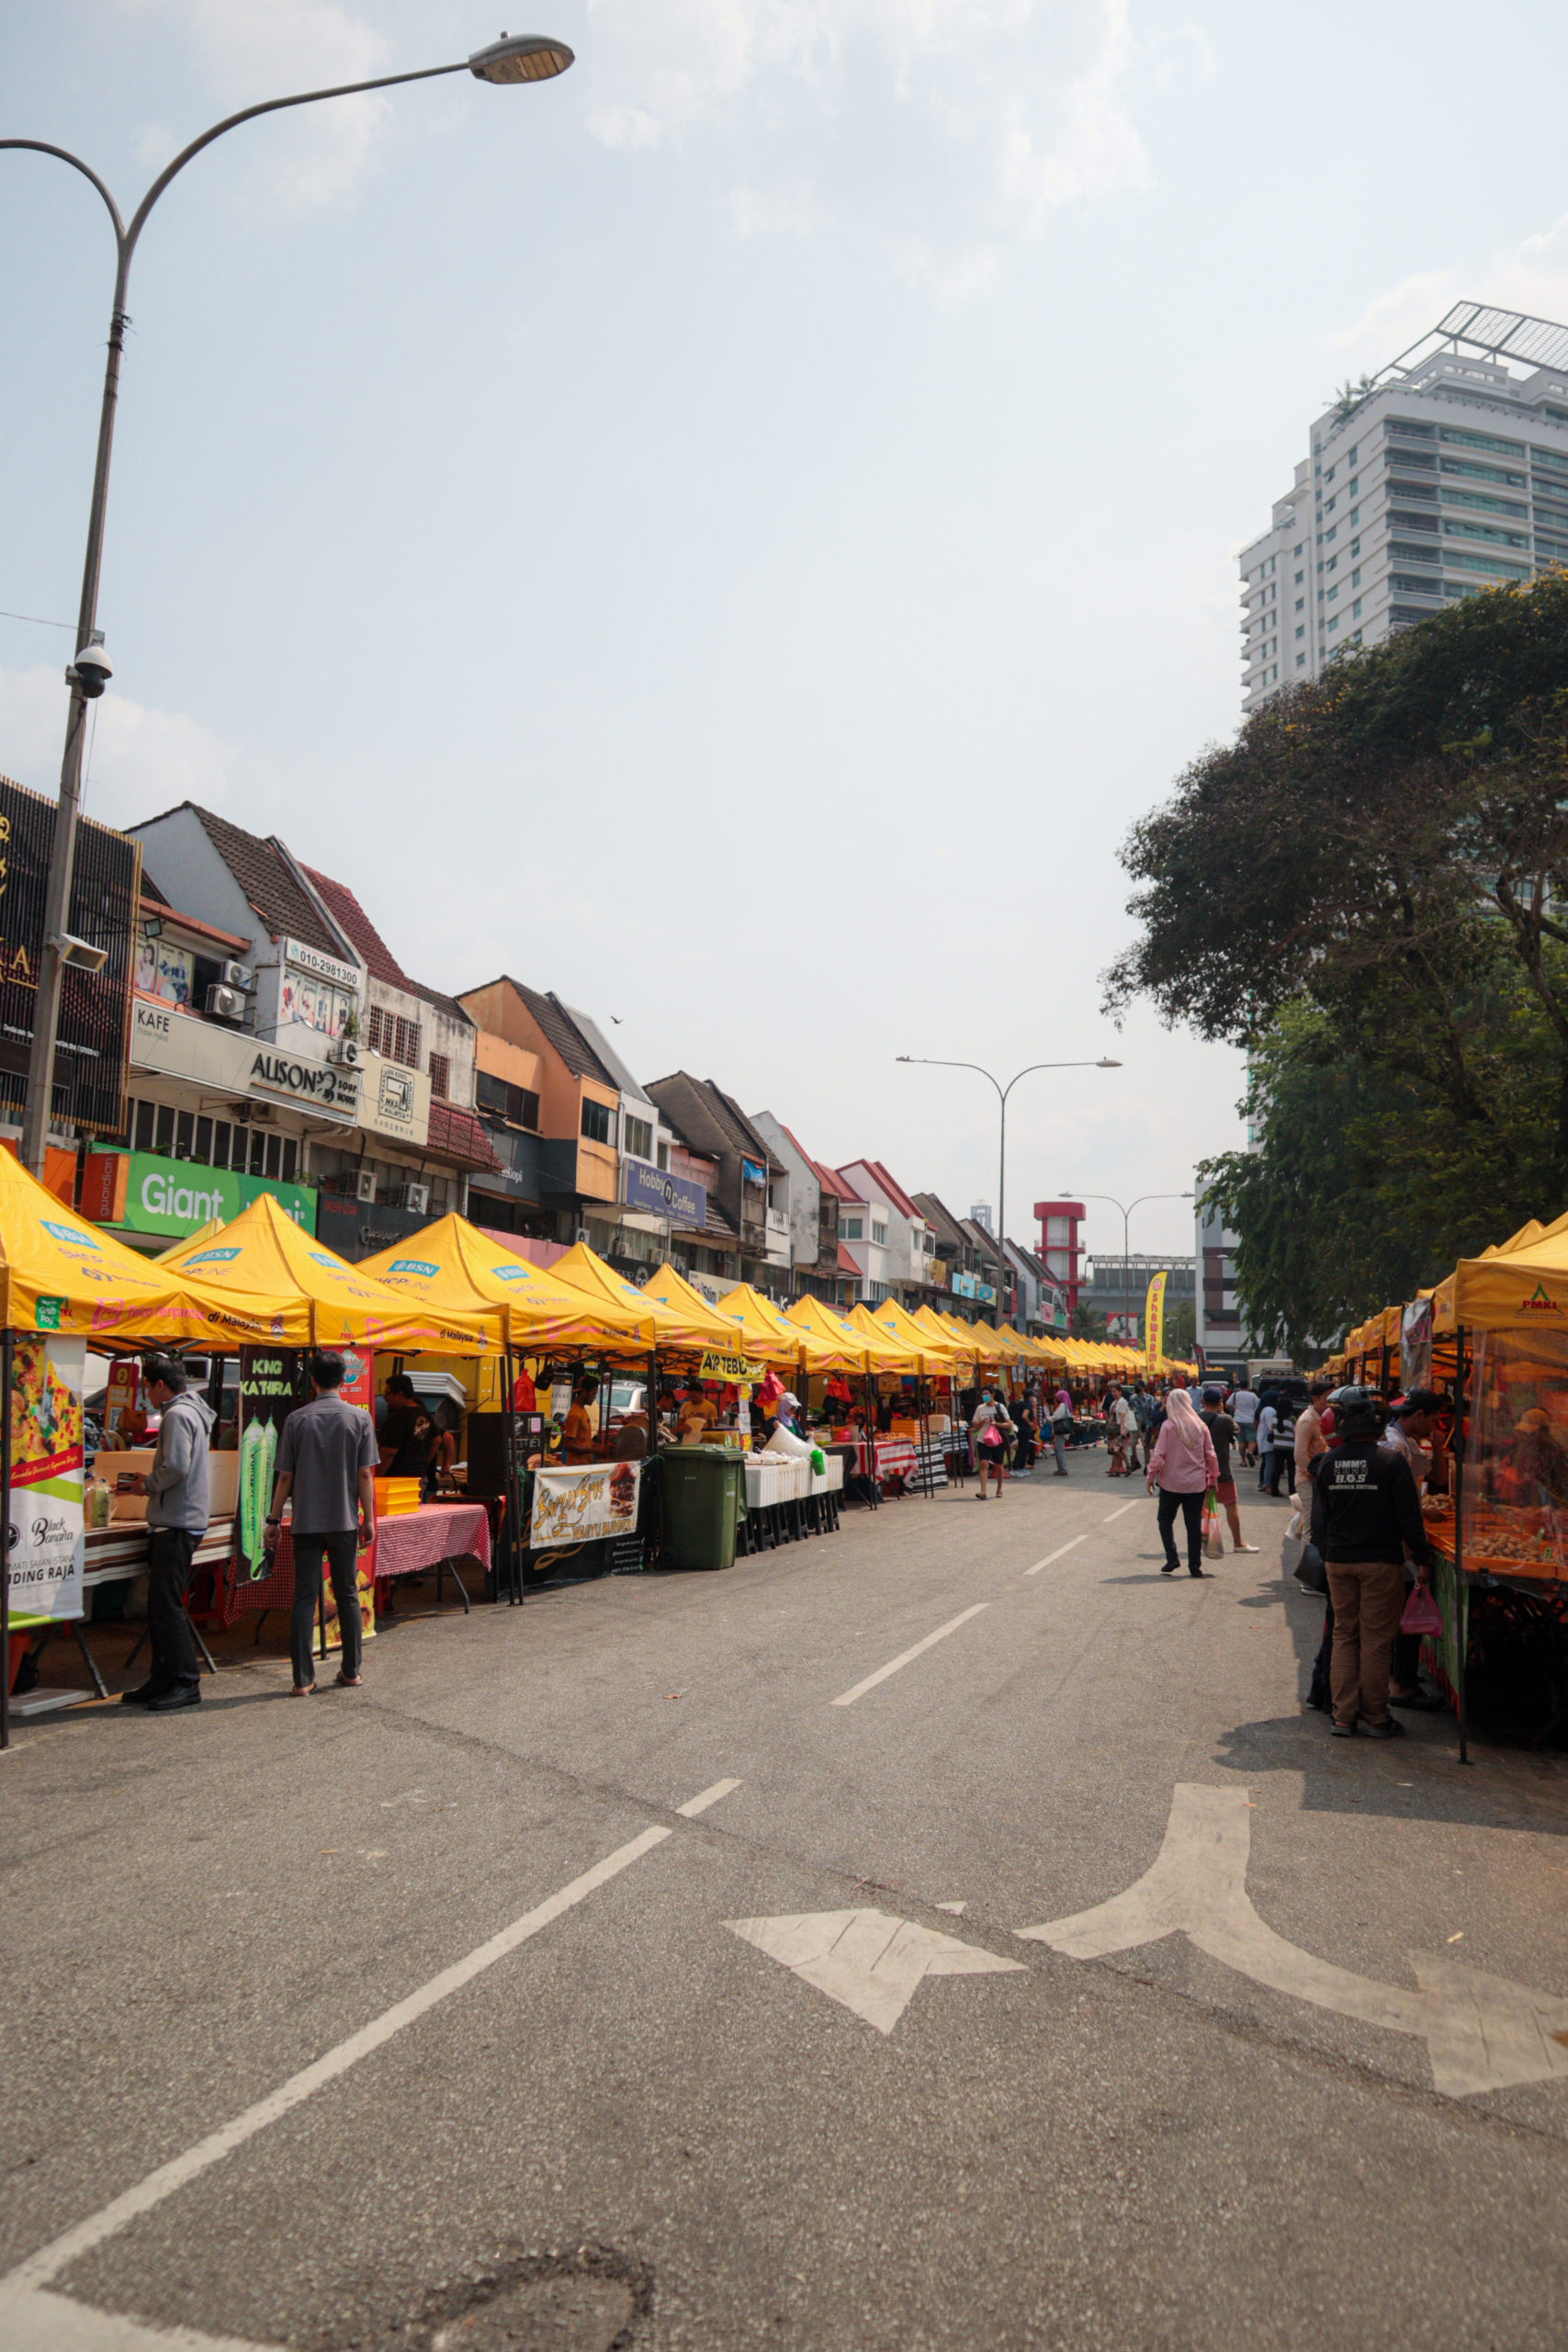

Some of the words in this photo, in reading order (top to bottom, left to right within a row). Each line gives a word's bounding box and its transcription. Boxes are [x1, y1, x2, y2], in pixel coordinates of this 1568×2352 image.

[299, 951, 357, 985] 010-2981300
[138, 1009, 170, 1033] KAFE
[386, 1097, 399, 1109] MKA
[99, 1157, 113, 1217] guardian
[639, 1168, 666, 1196] Hobby
[671, 1193, 695, 1215] Coffee
[141, 1172, 223, 1221] Giant
[204, 1248, 235, 1261] BSN
[407, 1262, 434, 1274] BSN
[39, 1306, 56, 1316] Grab
[1523, 1300, 1558, 1309] PMKL
[40, 1315, 54, 1325] Pay
[208, 1311, 220, 1322] di
[439, 1328, 447, 1339] di
[447, 1329, 474, 1343] Malaysia
[572, 1522, 602, 1541] WAGYU
[48, 1564, 74, 1580] RAJA
